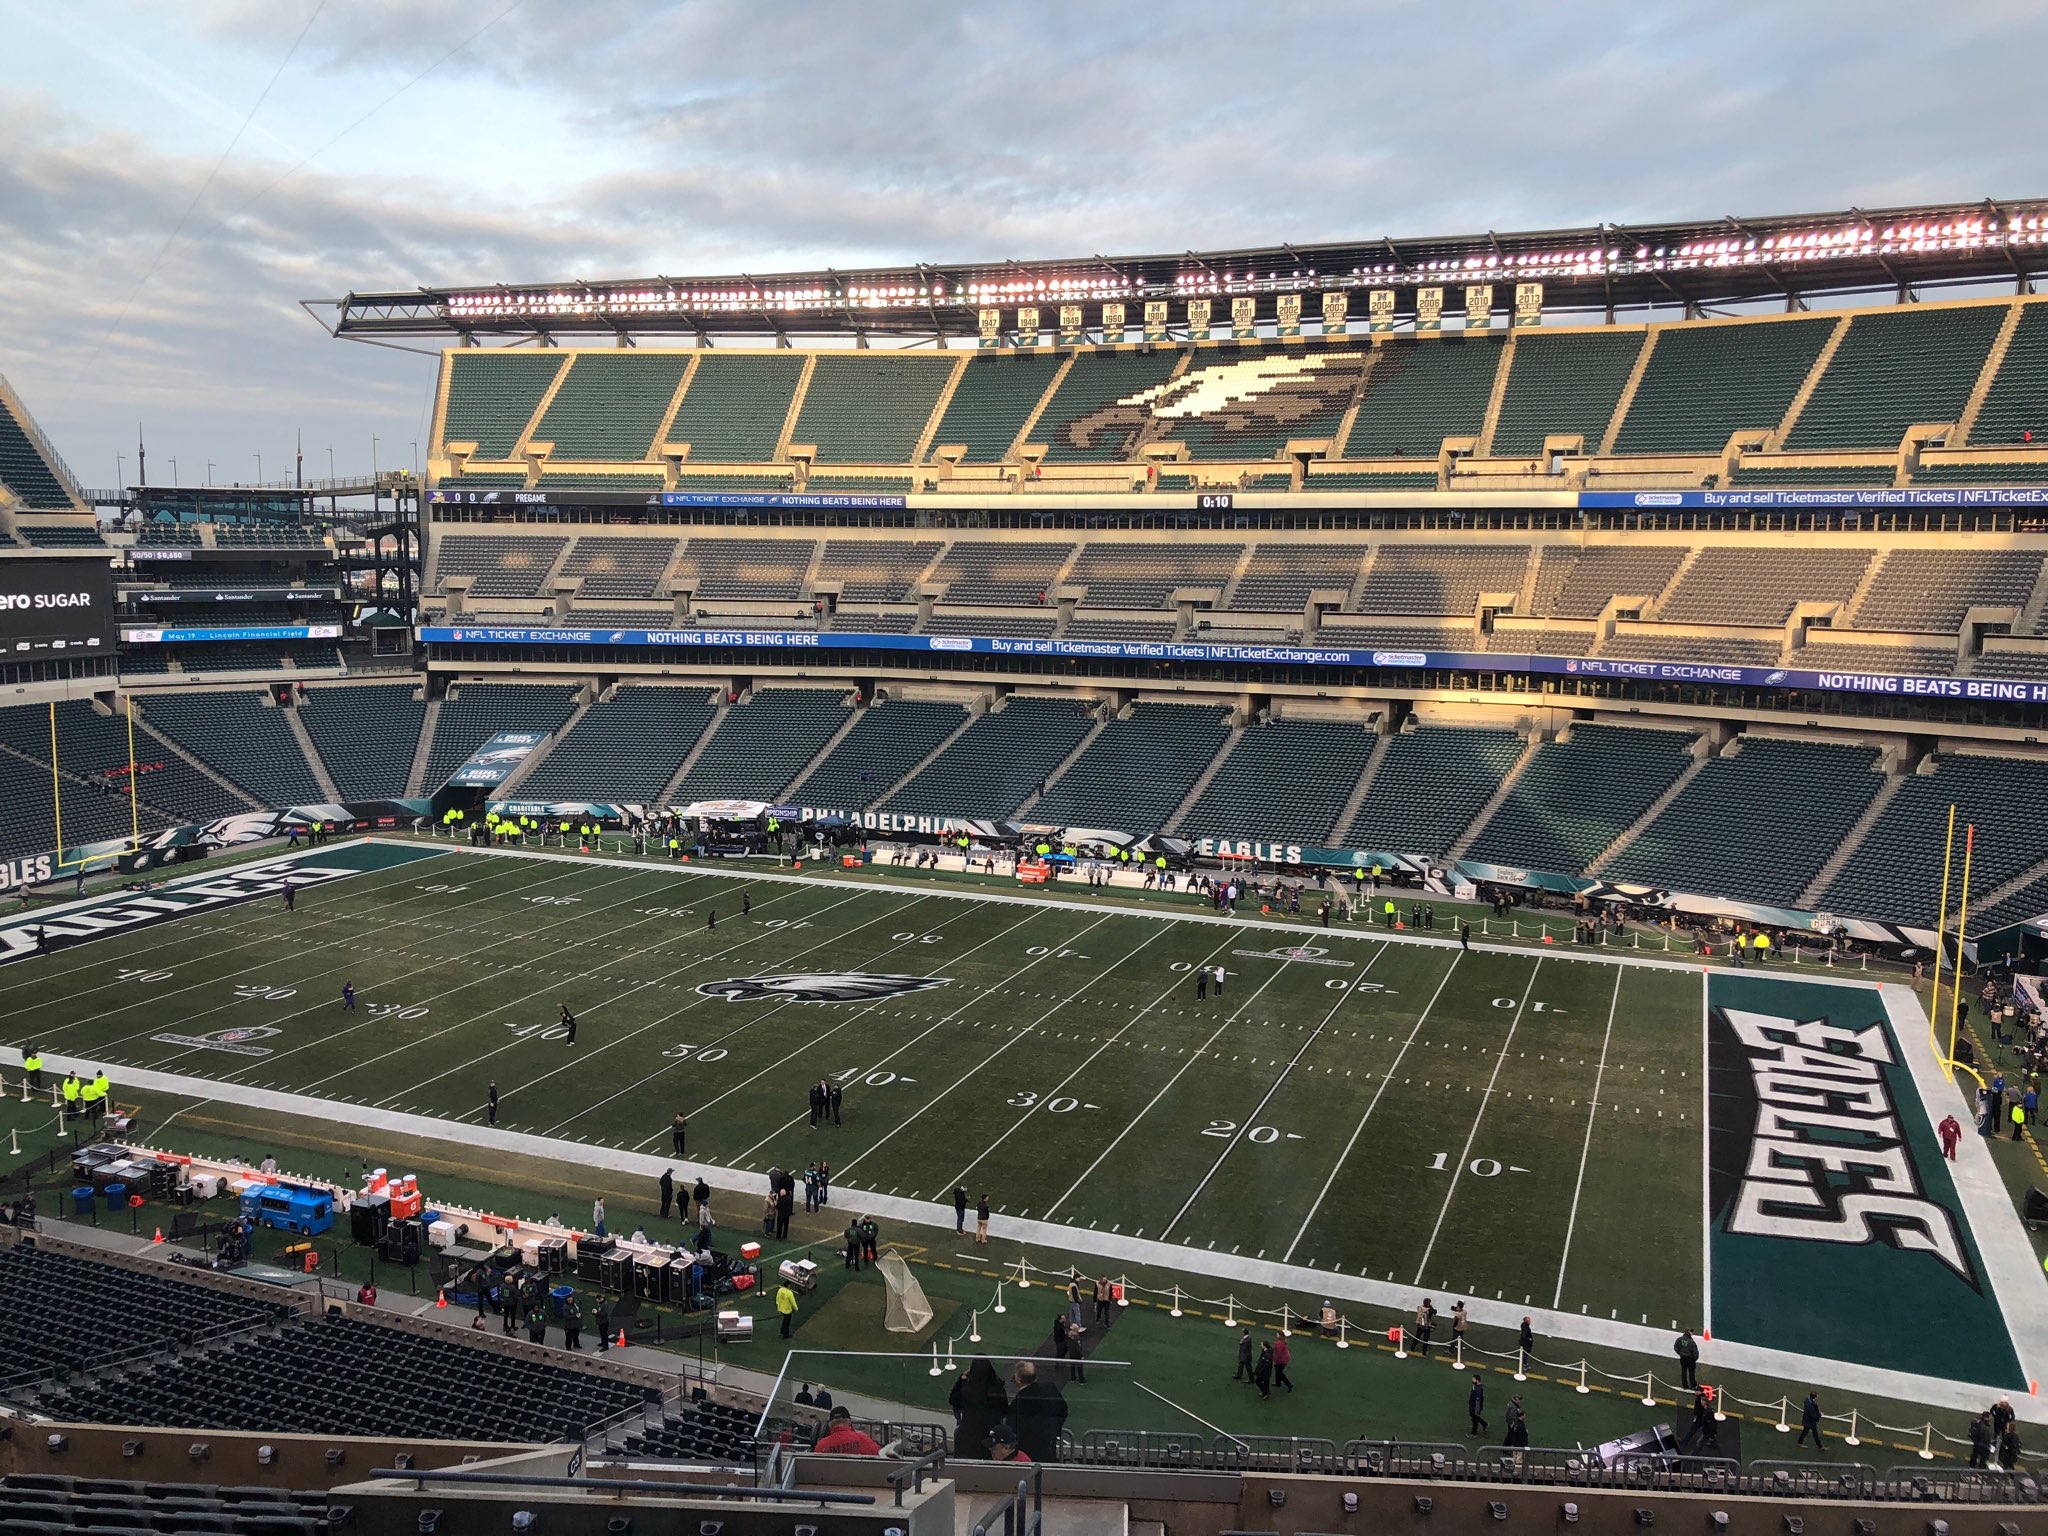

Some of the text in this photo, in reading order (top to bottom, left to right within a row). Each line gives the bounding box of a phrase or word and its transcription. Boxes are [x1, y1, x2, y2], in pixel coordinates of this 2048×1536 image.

[1420, 299, 1440, 308] 2006
[1469, 297, 1488, 306] 2010
[1519, 295, 1540, 304] 2013
[1279, 306, 1298, 314] 2002
[1325, 304, 1344, 312] 2003
[1372, 302, 1392, 310] 2004
[1190, 310, 1208, 318] 1988
[1234, 308, 1252, 316] 2001
[981, 319, 997, 327] 1947
[1020, 318, 1037, 326] 1948
[1063, 316, 1080, 324] 1949
[1105, 314, 1122, 322] 1960
[470, 494, 475, 502] 0
[516, 494, 546, 502] PREGAME
[782, 496, 902, 506] NOTHING BEATS BEING HERE
[1202, 496, 1228, 508] 0:10
[1704, 494, 1725, 505] Buy
[1729, 493, 1751, 503] and
[1754, 493, 1773, 503] sell
[1776, 492, 1854, 503] Ticketmaster
[1857, 491, 1905, 503] Verified
[1908, 491, 1955, 502] Tickets
[1964, 490, 2048, 502] NFLTicketEx
[34, 593, 90, 608] SUGAR
[466, 630, 591, 641] NFL TICKET EXCHANGE
[647, 632, 818, 646] NOTHING BEATS BEING HERE
[992, 640, 1011, 652] Buy
[1014, 640, 1033, 651] and
[1035, 640, 1052, 652] sell
[1054, 642, 1120, 654] Ticketmaster
[1123, 644, 1164, 656] Verified
[1166, 645, 1204, 658] Tickets
[1212, 647, 1350, 662] NFLTicketExchange.com
[1581, 661, 1742, 680] NFL TICKET EXCHANGE
[1818, 674, 1897, 692] NOTHING
[1903, 678, 1961, 696] BEATS
[1967, 682, 2026, 700] BEING
[1202, 838, 1301, 864] EAGLES
[115, 968, 174, 983] 10
[233, 985, 297, 1001] 20
[369, 1003, 430, 1020] 30
[661, 1044, 729, 1063] 50
[828, 1067, 896, 1087] 40
[1006, 1091, 1081, 1114] 30
[1201, 1120, 1279, 1144] 20
[1715, 1006, 1967, 1275] EAGLES
[1425, 1152, 1503, 1179] 10
[410, 1202, 417, 1211] G
[1391, 1330, 1400, 1341] 10
